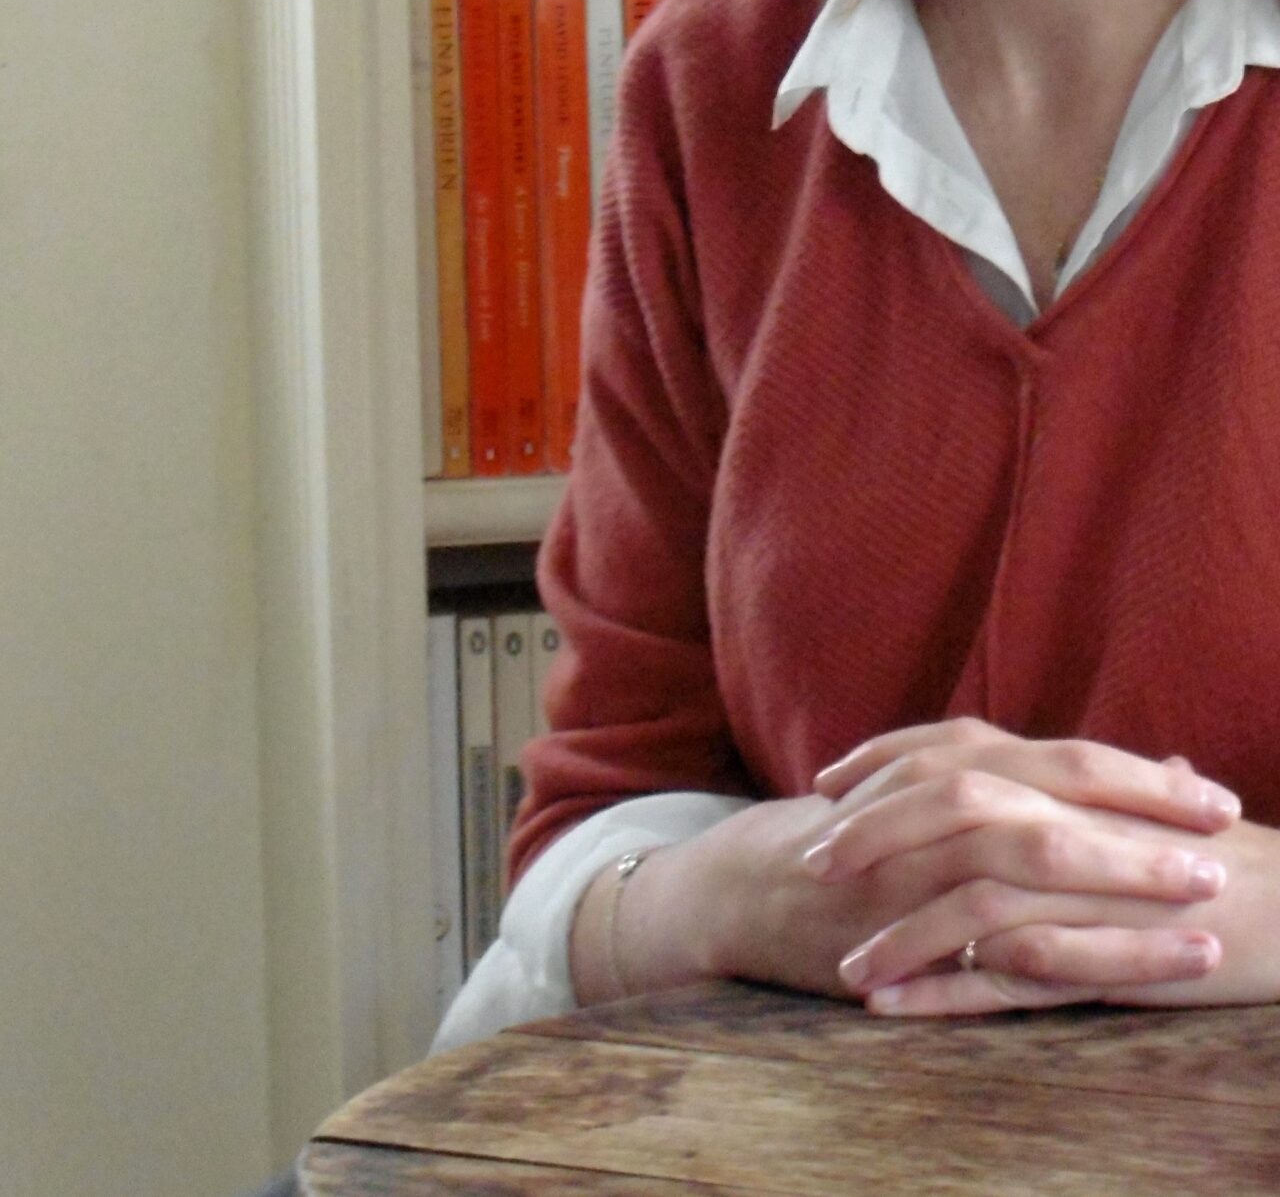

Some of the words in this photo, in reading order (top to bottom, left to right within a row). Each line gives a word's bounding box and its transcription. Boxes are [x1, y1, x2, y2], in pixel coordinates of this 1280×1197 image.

[436, 6, 454, 75] EDNA
[509, 14, 524, 86] ROLAND
[554, 4, 569, 62] DAVID
[556, 64, 570, 127] LODGE
[475, 217, 491, 290] Experiment
